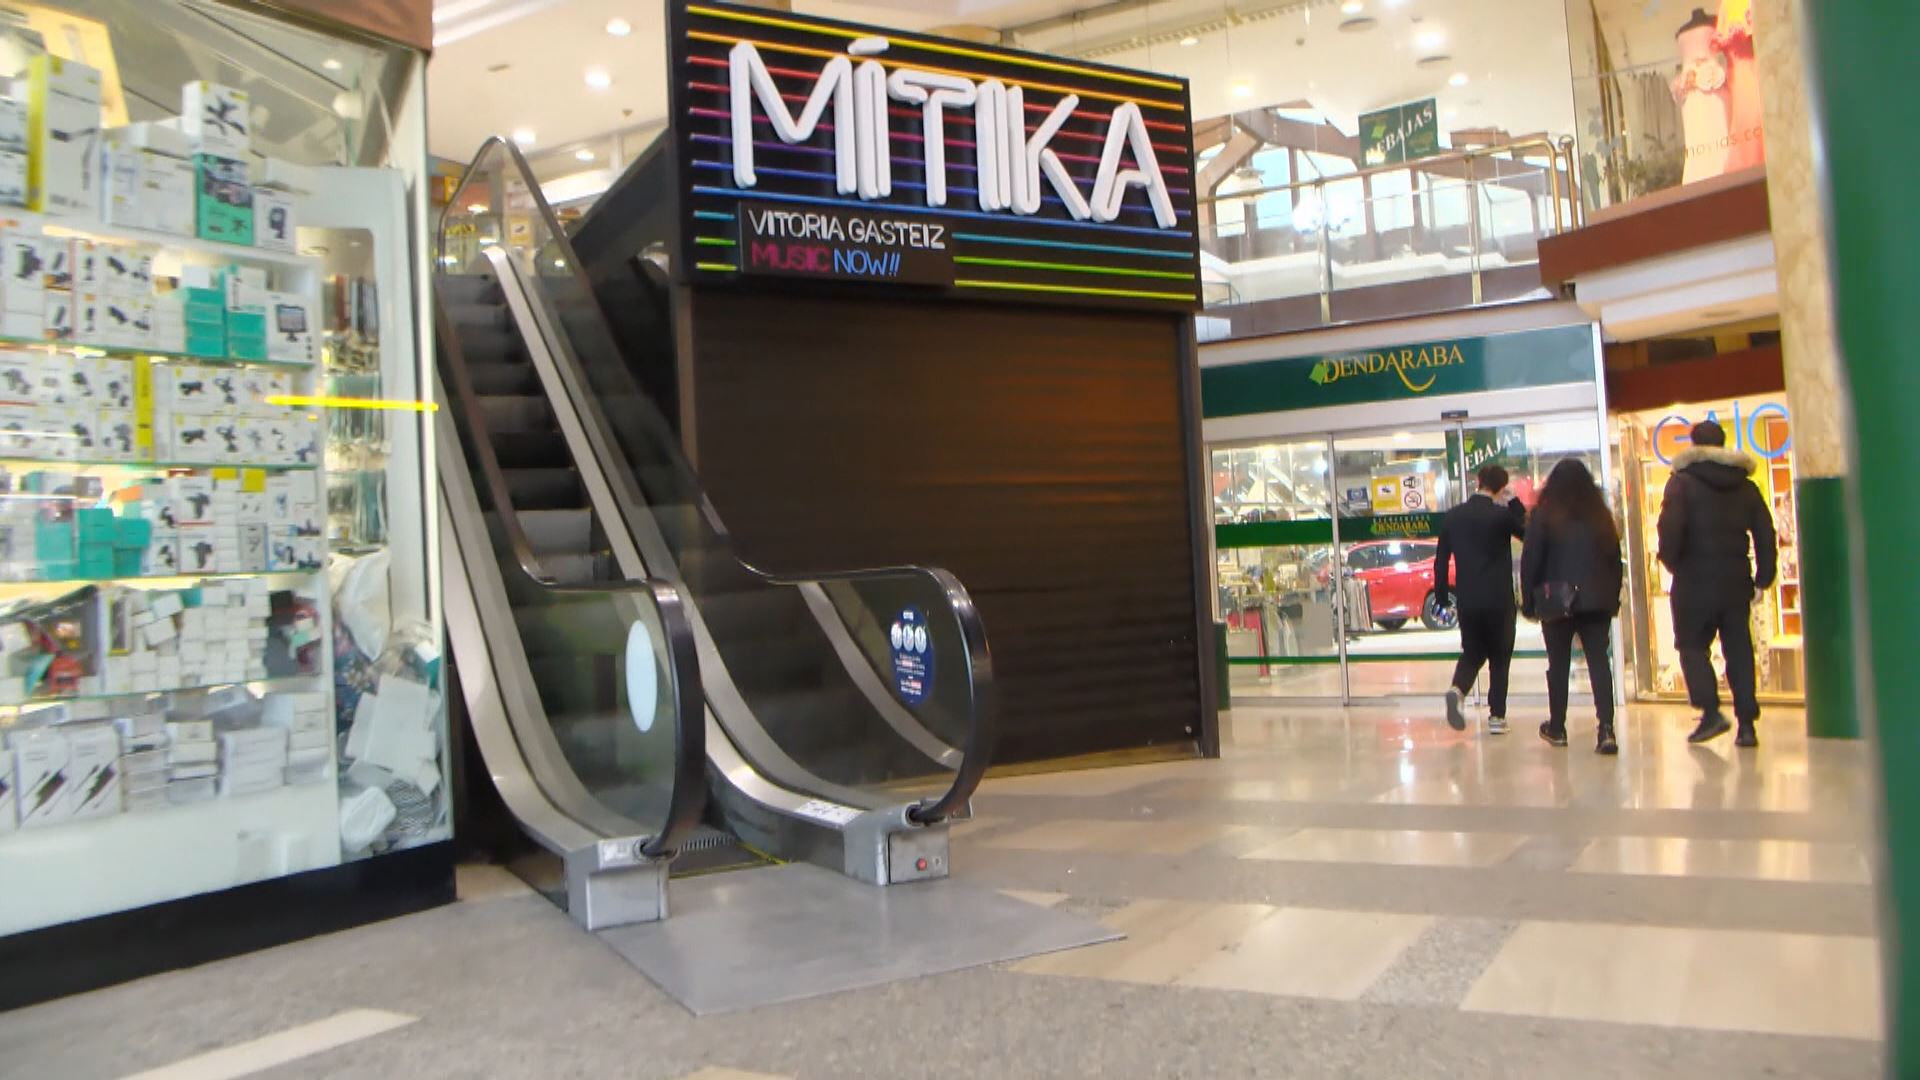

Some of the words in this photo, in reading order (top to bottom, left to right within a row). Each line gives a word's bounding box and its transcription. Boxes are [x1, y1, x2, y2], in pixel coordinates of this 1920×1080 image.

[729, 36, 1178, 229] MÍTIKA
[748, 209, 846, 242] VITORIA
[848, 218, 946, 250] GASTEIZ
[751, 241, 831, 273] MUSIC
[1323, 344, 1464, 392] DENDARABA
